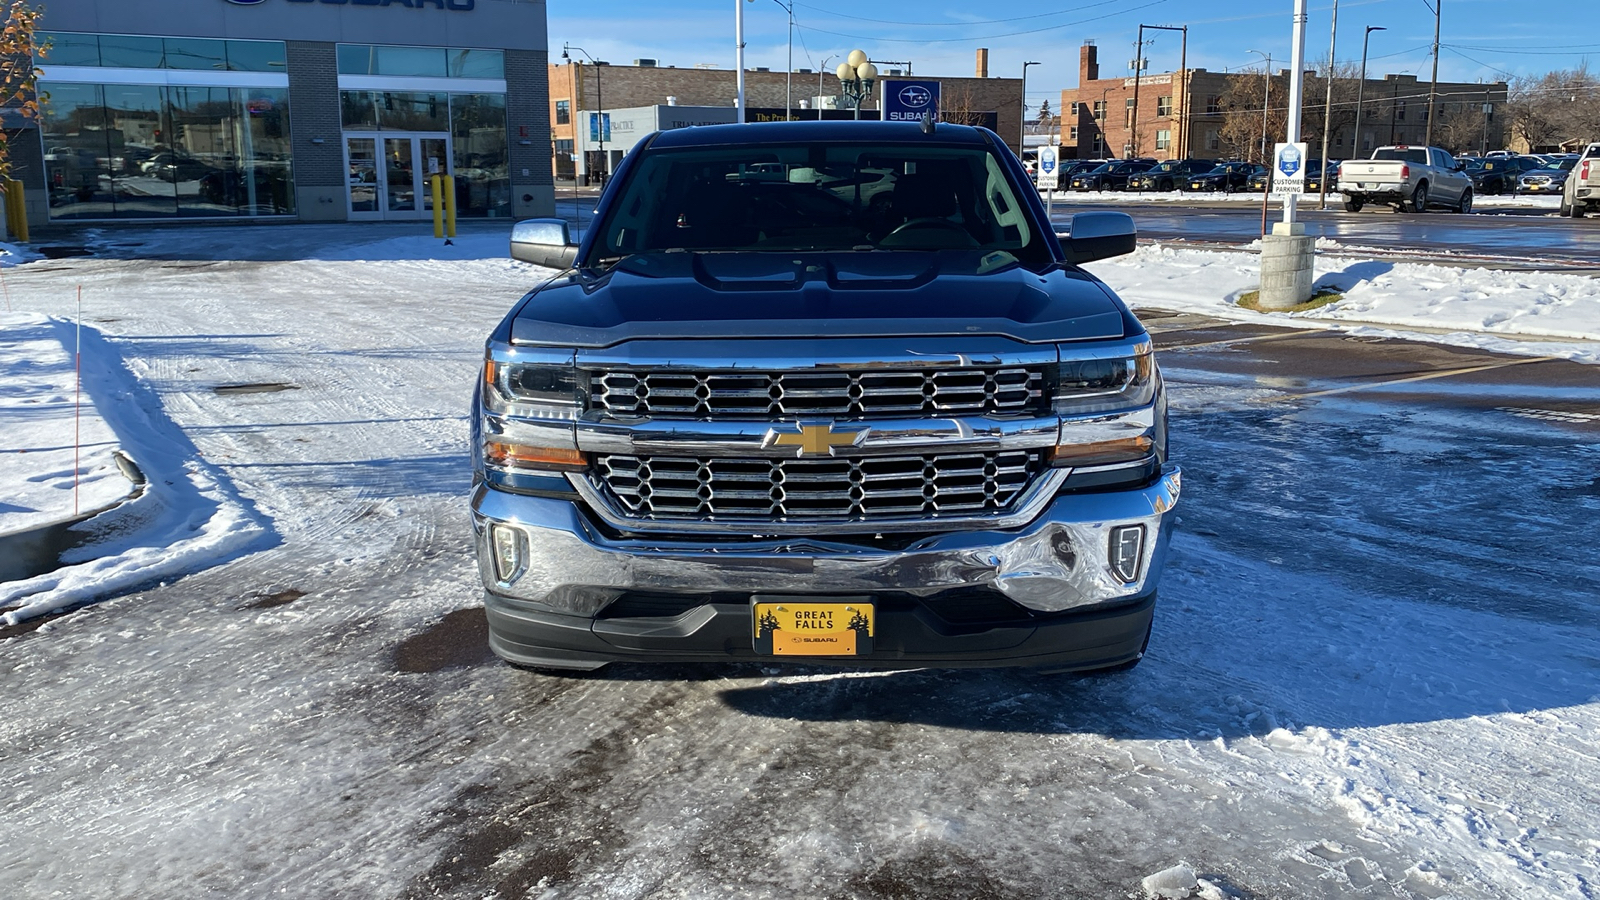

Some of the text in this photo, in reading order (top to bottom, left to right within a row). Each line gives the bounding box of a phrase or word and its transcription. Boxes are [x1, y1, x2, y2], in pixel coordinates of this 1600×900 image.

[755, 113, 800, 121] The Pracice
[795, 611, 833, 619] GREAT
[795, 620, 834, 629] FALLS
